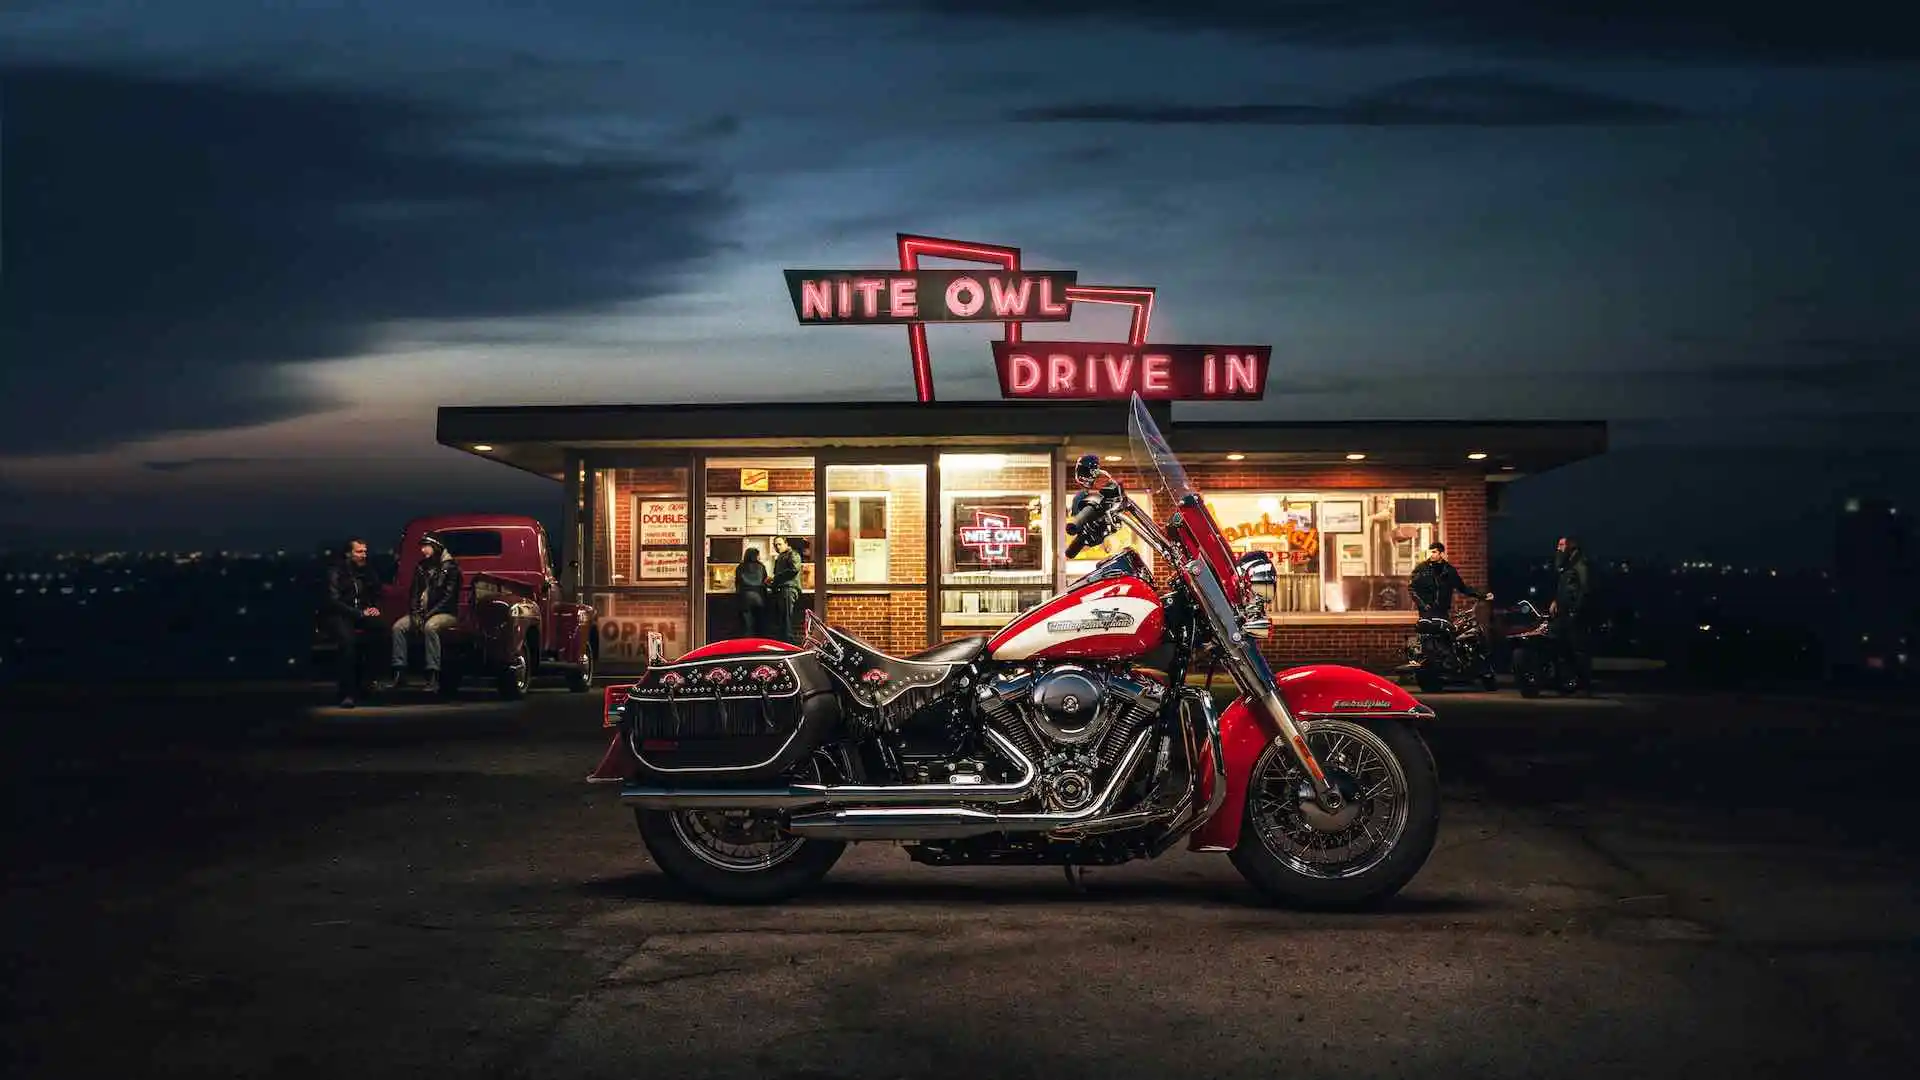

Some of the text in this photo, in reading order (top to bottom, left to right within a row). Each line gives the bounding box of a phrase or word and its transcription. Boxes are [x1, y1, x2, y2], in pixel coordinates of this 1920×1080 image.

[801, 276, 1068, 319] NITE OWL
[1008, 353, 1258, 394] DRIVE IN
[643, 514, 691, 524] DOUBLES
[964, 529, 1023, 542] NITE OWL
[601, 621, 676, 642] OPEN
